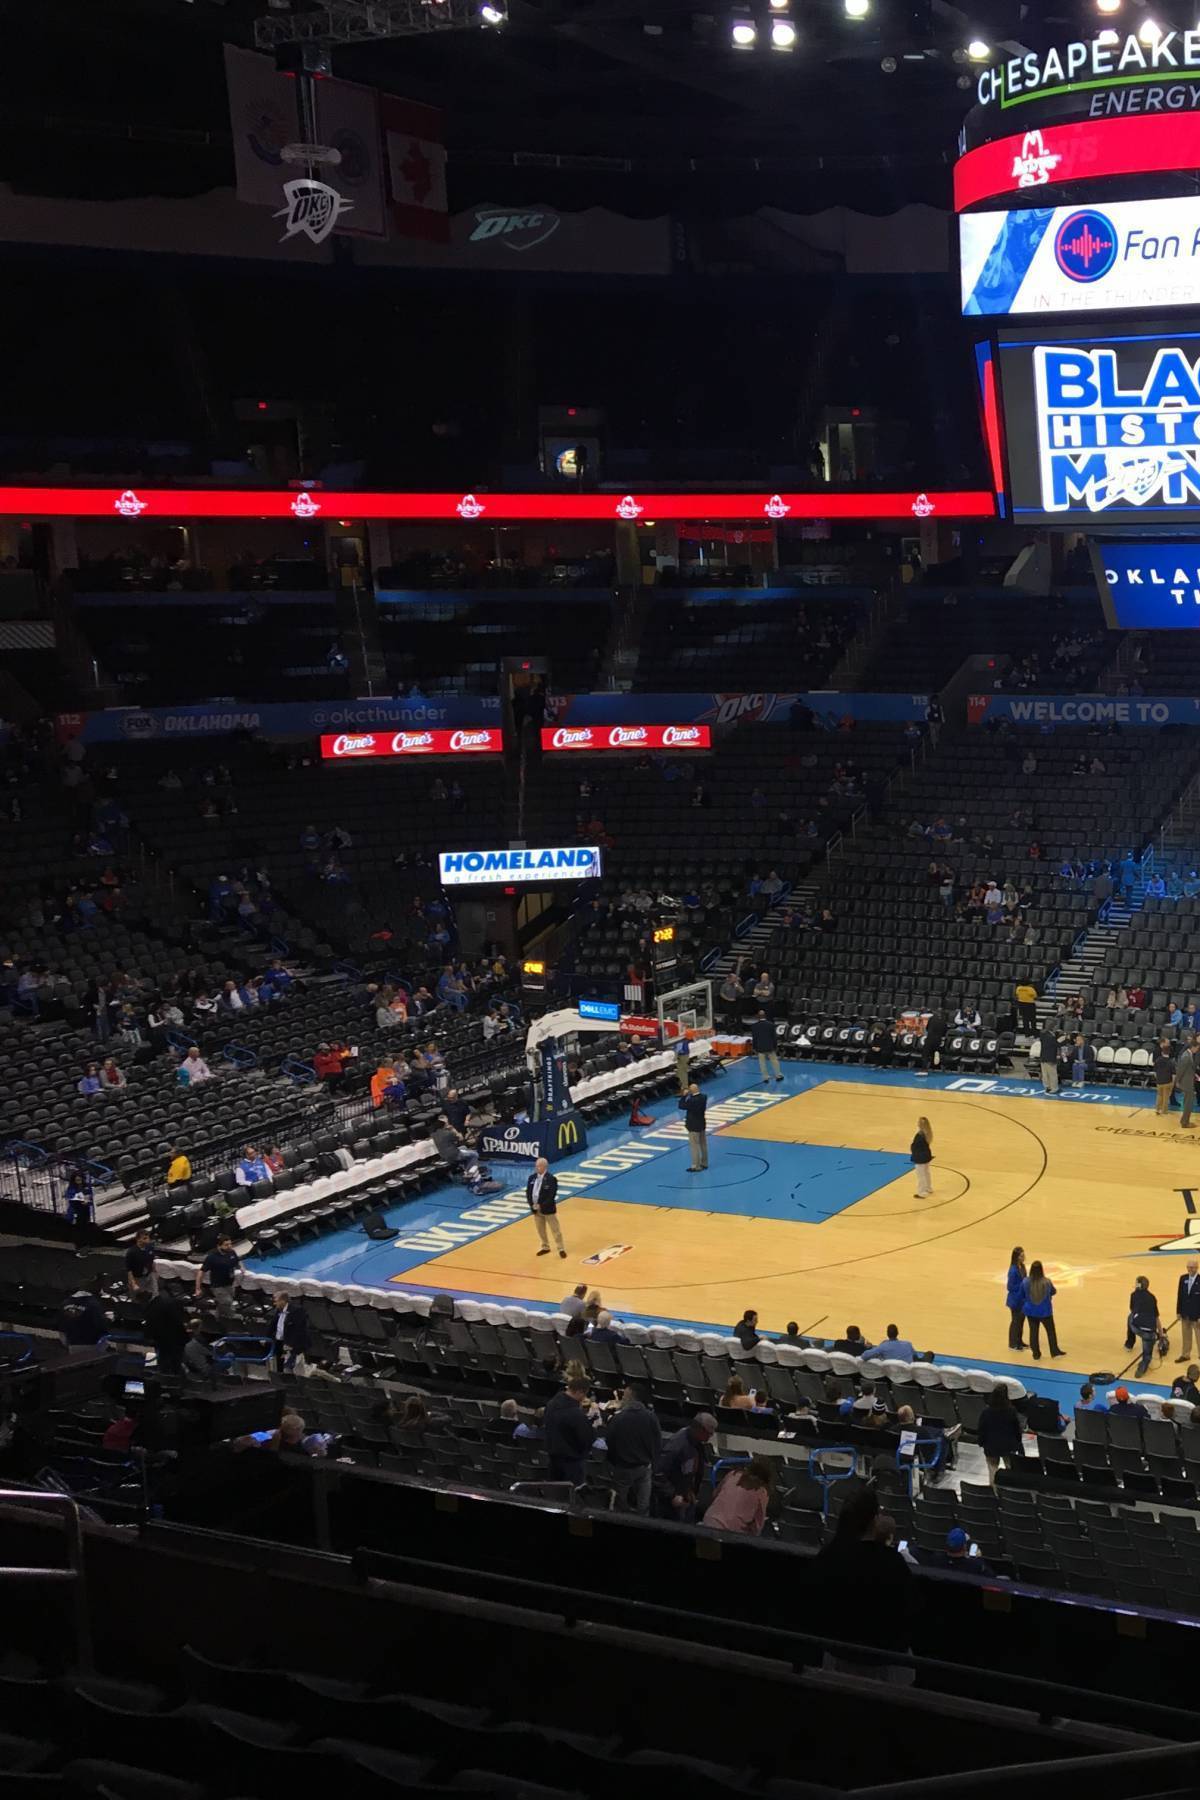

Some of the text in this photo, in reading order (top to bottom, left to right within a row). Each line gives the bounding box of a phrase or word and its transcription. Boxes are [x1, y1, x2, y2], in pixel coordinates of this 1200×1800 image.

[469, 211, 545, 242] OKC
[1124, 230, 1179, 261] Fan
[1033, 293, 1051, 308] IN
[1061, 290, 1095, 307] THE
[1104, 285, 1194, 304] THUNDER
[481, 698, 500, 709] 112
[968, 697, 986, 707] 114
[1010, 702, 1169, 722] WELCOME TO
[59, 713, 81, 726] 112
[164, 713, 260, 732] OKLAHOMA
[312, 705, 448, 728] @okcthunder
[333, 734, 377, 755] Cane's
[391, 732, 433, 752] Cane's
[449, 730, 492, 751] Cane's
[552, 728, 594, 749] Cane's
[609, 727, 648, 746] Cane's
[662, 726, 700, 746] Cane's
[444, 850, 594, 873] HOMELAND
[467, 872, 502, 882] fresh
[509, 869, 592, 881] experience
[482, 1136, 541, 1159] SPALDING
[579, 1140, 671, 1172] CITY
